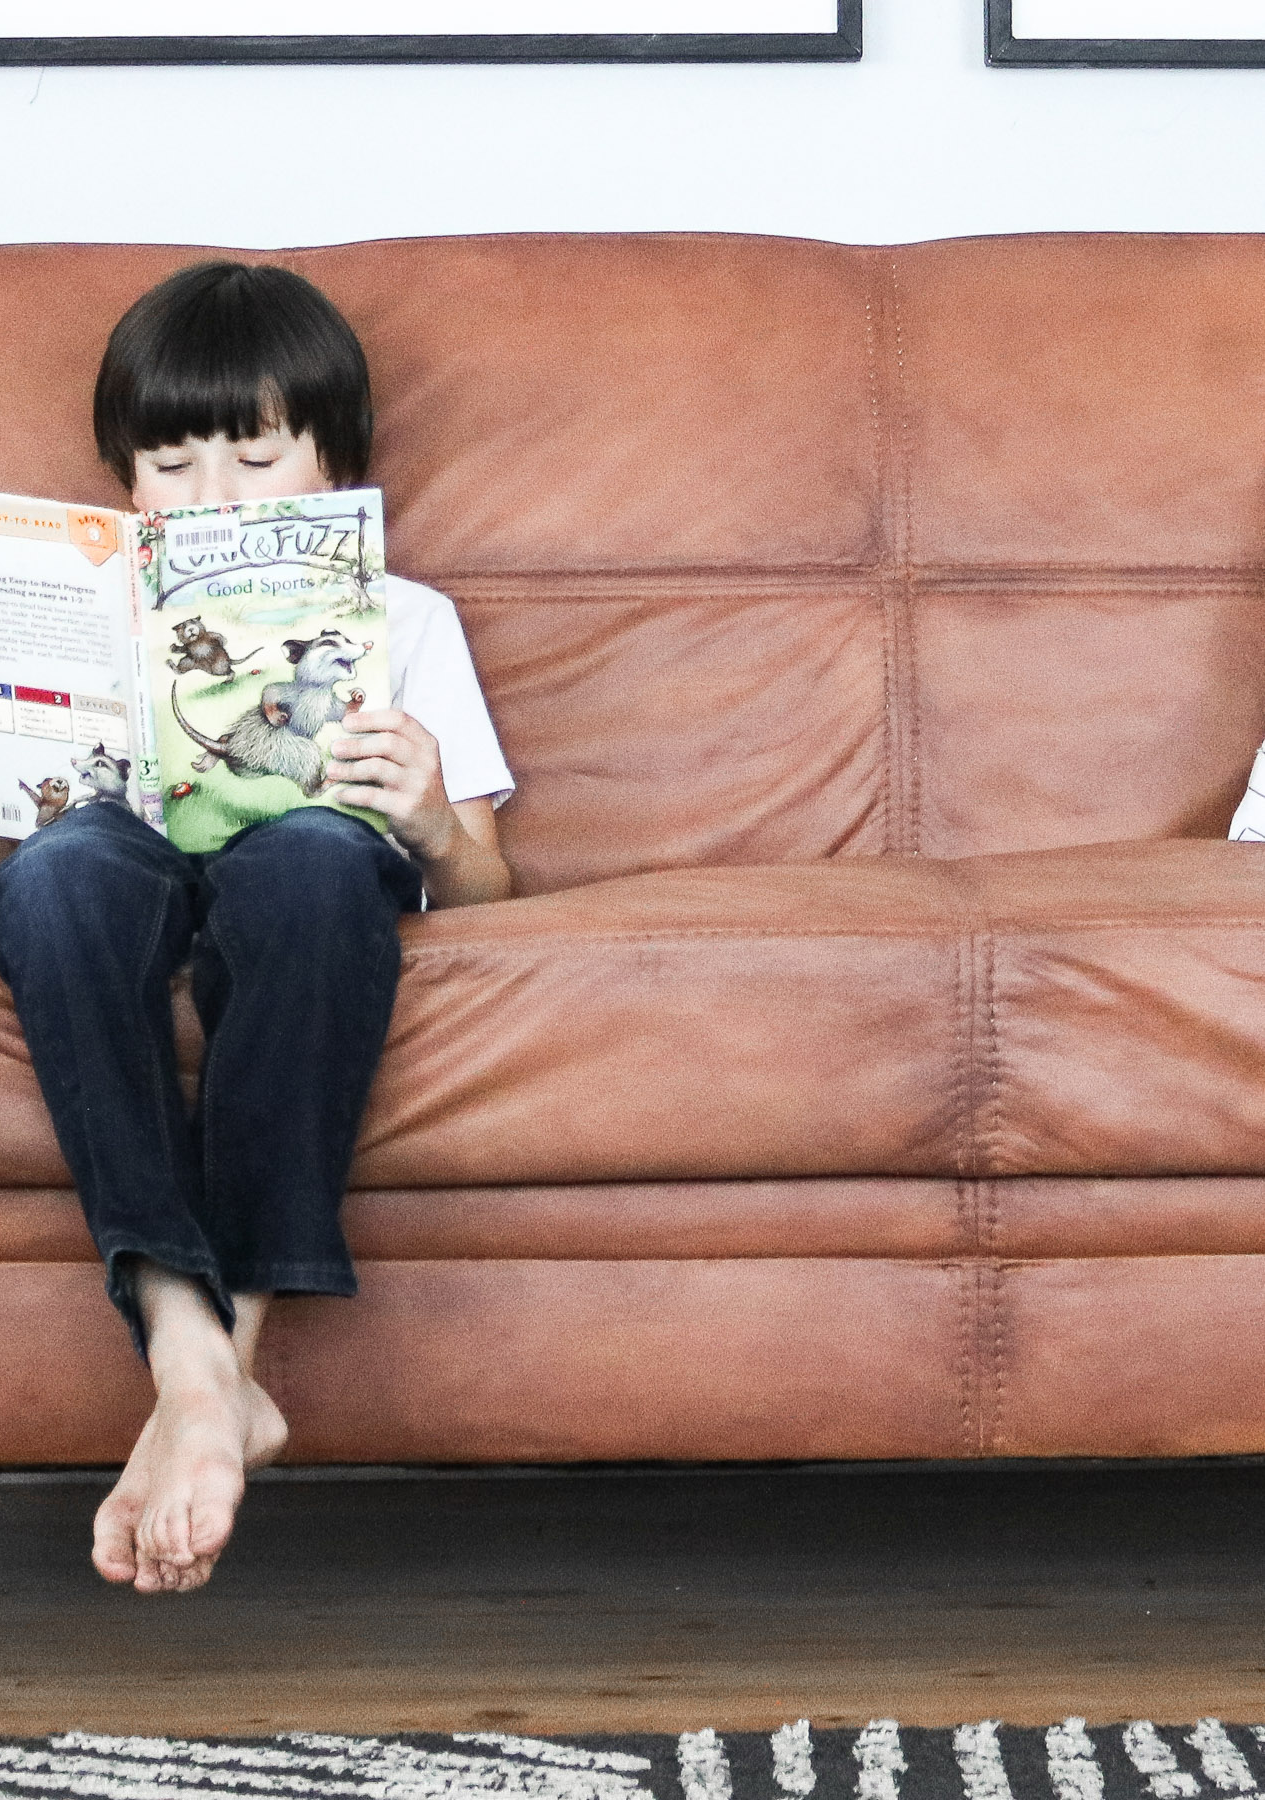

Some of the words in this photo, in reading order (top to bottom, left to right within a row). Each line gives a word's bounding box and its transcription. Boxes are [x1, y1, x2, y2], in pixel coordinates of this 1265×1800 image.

[270, 523, 358, 563] FUZZ
[63, 583, 97, 595] Program
[206, 578, 253, 597] Good
[260, 577, 316, 597] Sports
[39, 592, 57, 602] easy
[54, 694, 64, 705] 2
[139, 758, 159, 776] 3rd
